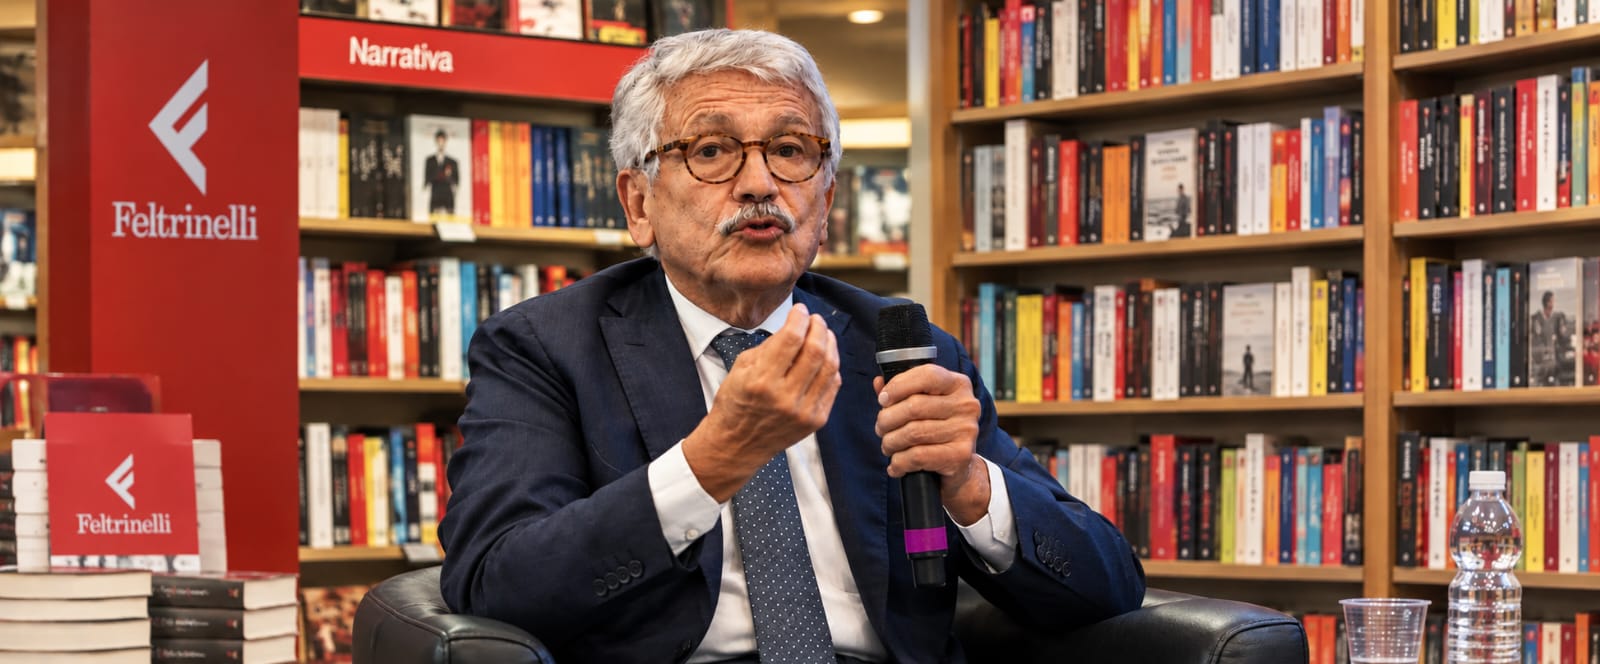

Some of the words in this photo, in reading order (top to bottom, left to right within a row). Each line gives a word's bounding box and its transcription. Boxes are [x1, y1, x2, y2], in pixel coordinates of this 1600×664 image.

[349, 36, 454, 73] Narrativa
[112, 201, 258, 240] Feltrinelli
[76, 512, 172, 534] Feltrinelli
